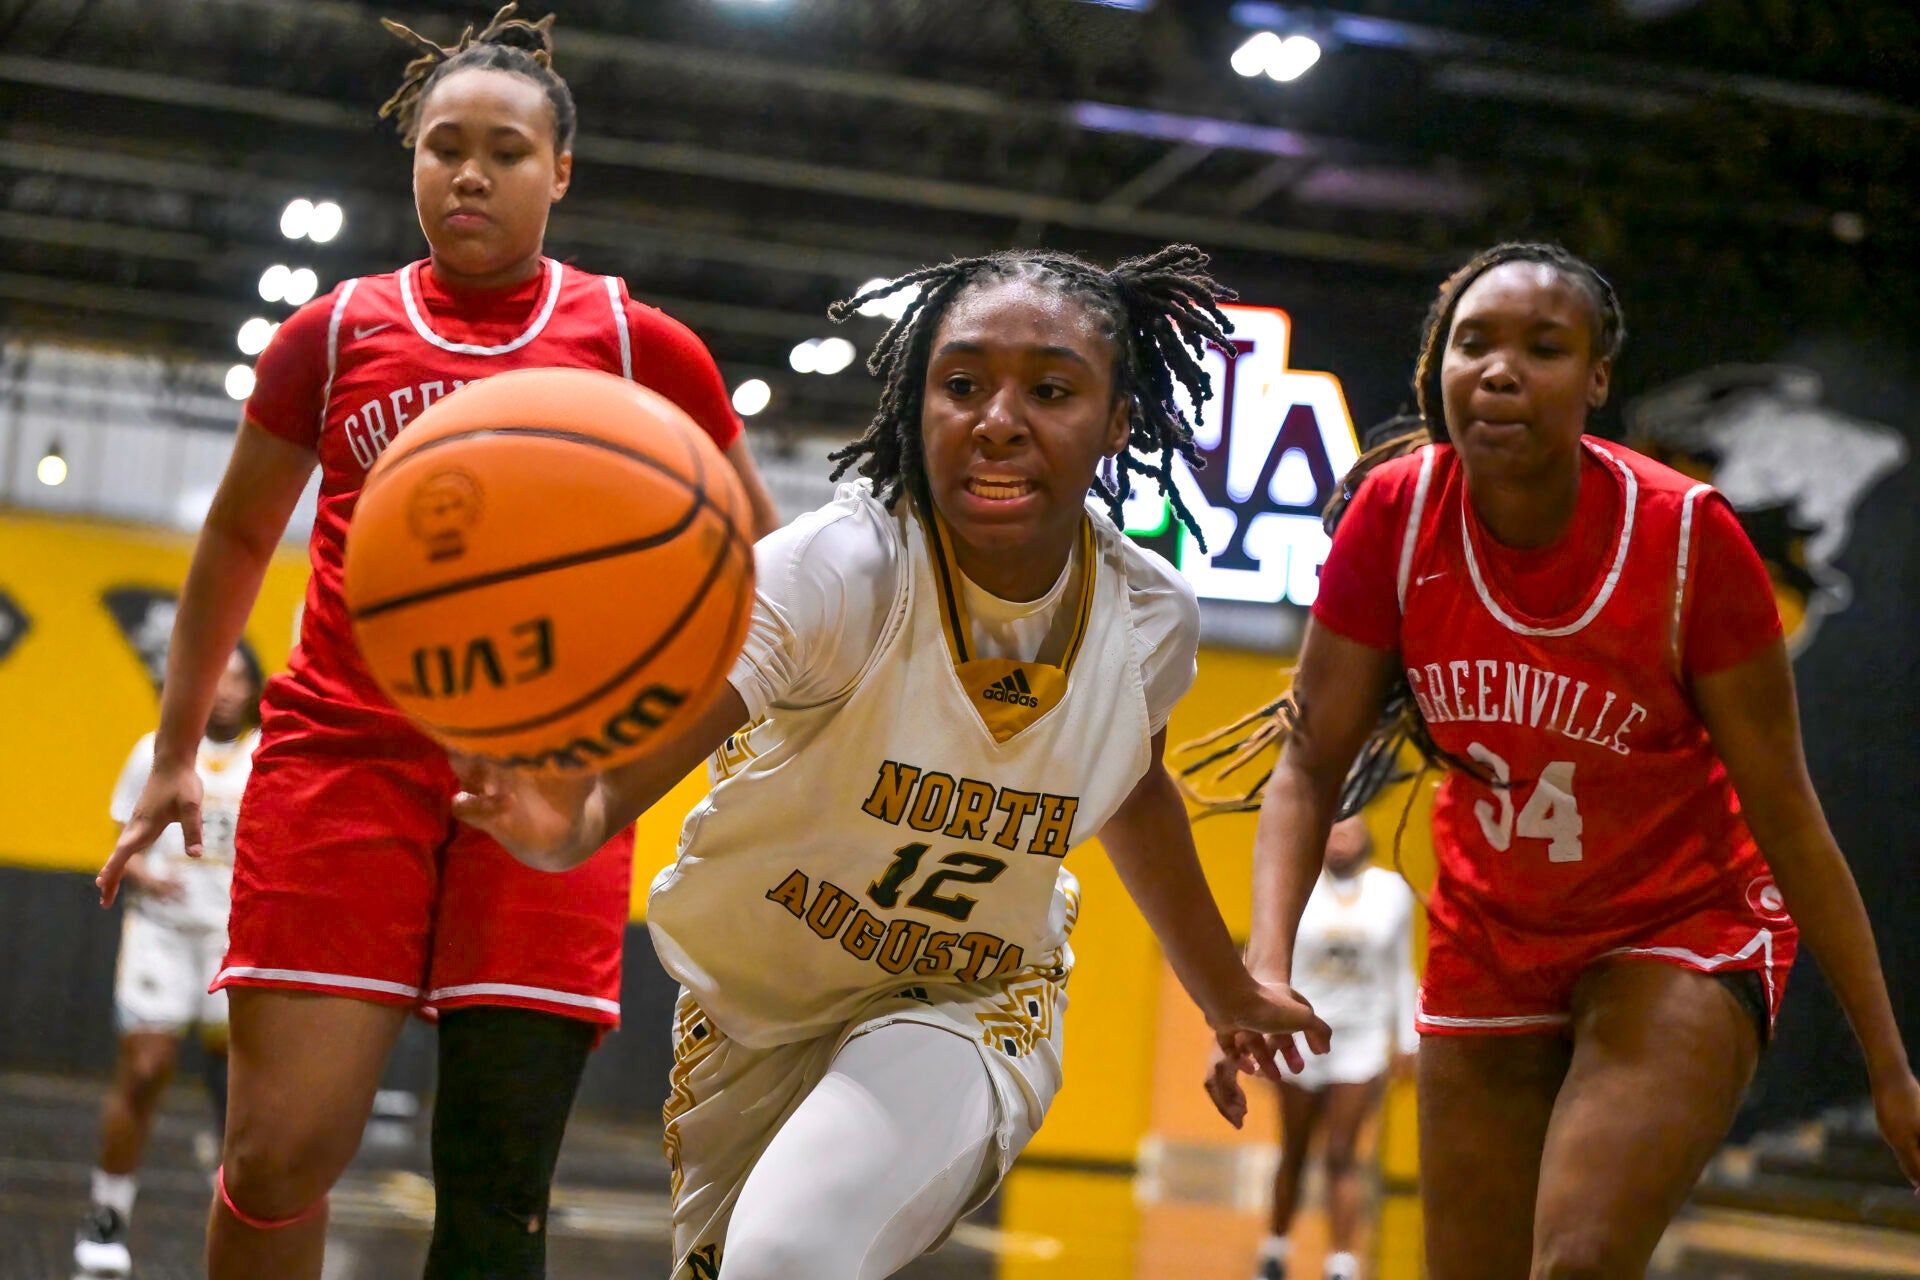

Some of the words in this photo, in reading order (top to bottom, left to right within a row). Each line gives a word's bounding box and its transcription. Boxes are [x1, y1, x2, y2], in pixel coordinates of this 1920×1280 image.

[982, 687, 1039, 709] adidas
[1407, 660, 1647, 756] GREENVILLE
[861, 759, 1080, 859] NORTH
[1466, 741, 1583, 863] 34
[765, 868, 1025, 983] AUGUSTA
[865, 841, 1009, 923] 12
